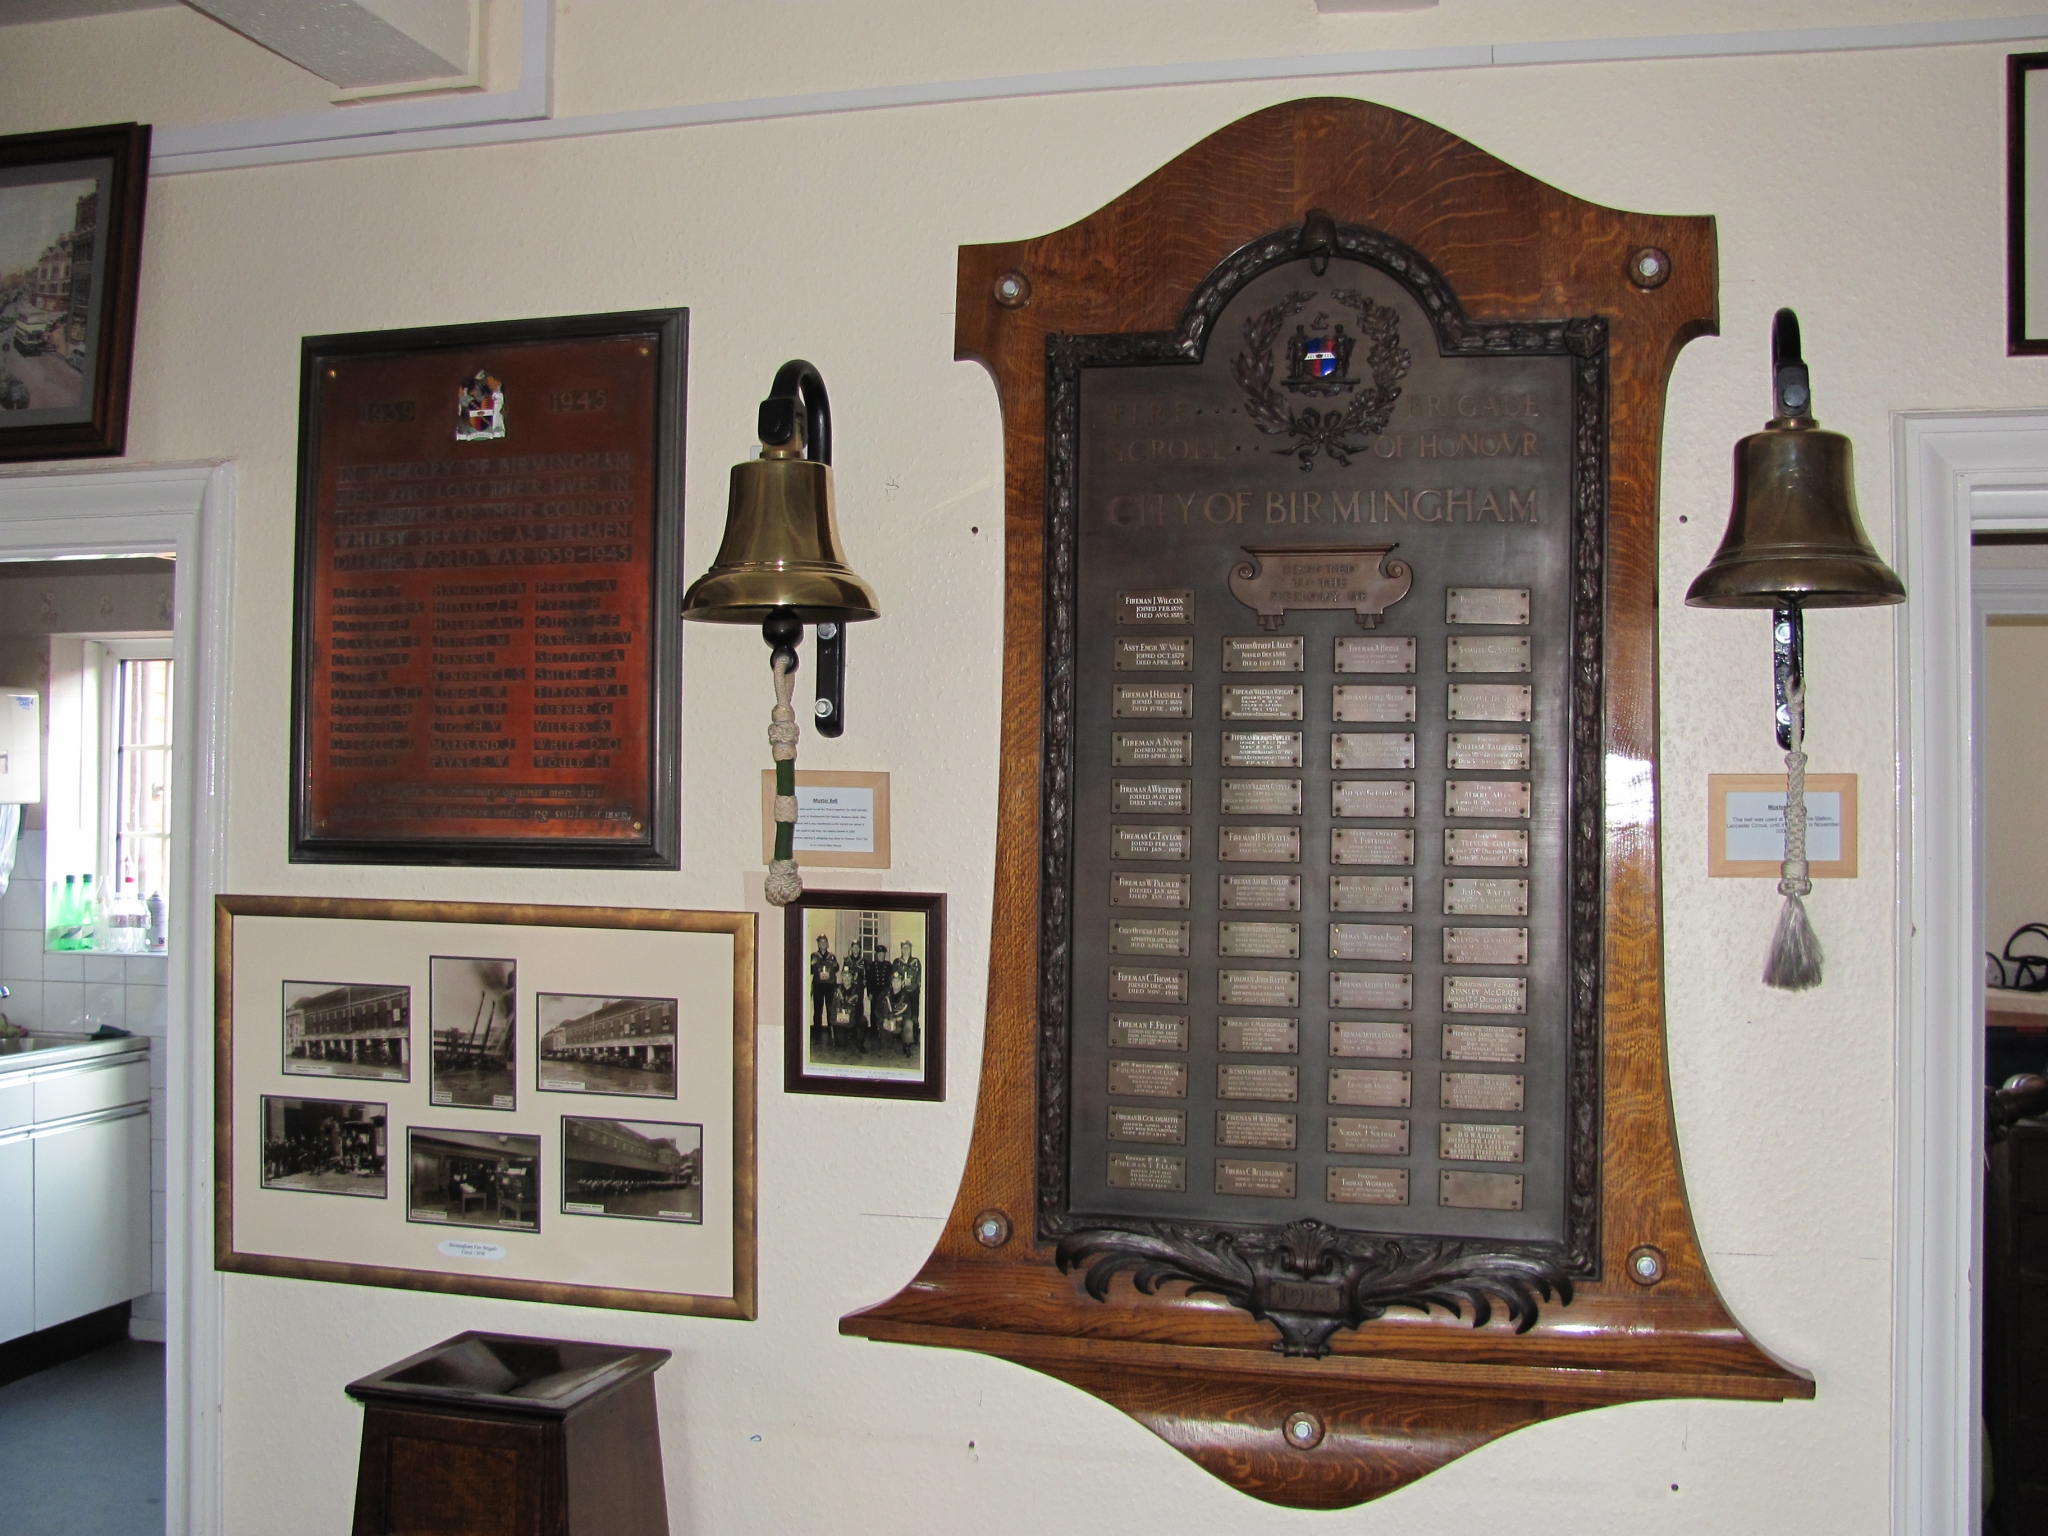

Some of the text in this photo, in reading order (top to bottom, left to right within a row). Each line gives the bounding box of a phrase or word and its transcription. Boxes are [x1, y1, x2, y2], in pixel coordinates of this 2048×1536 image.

[552, 391, 607, 412] 1945
[1111, 394, 1539, 426] FIRE BRIGADE
[1108, 438, 1226, 462] SCROLL
[1373, 434, 1407, 459] OF
[466, 458, 491, 475] OF
[500, 453, 633, 474] BIRMINGHAM
[490, 479, 541, 497] THEIR
[550, 476, 600, 494] LIVES
[610, 474, 630, 491] IN
[452, 504, 476, 521] OF
[543, 499, 632, 517] COUNTRY
[1108, 489, 1539, 527] CITY OF BIRMINGHAM
[336, 522, 629, 547] WHILST SERVING AS FIREMEN
[415, 550, 479, 567] WORLD
[490, 548, 527, 565] WAR
